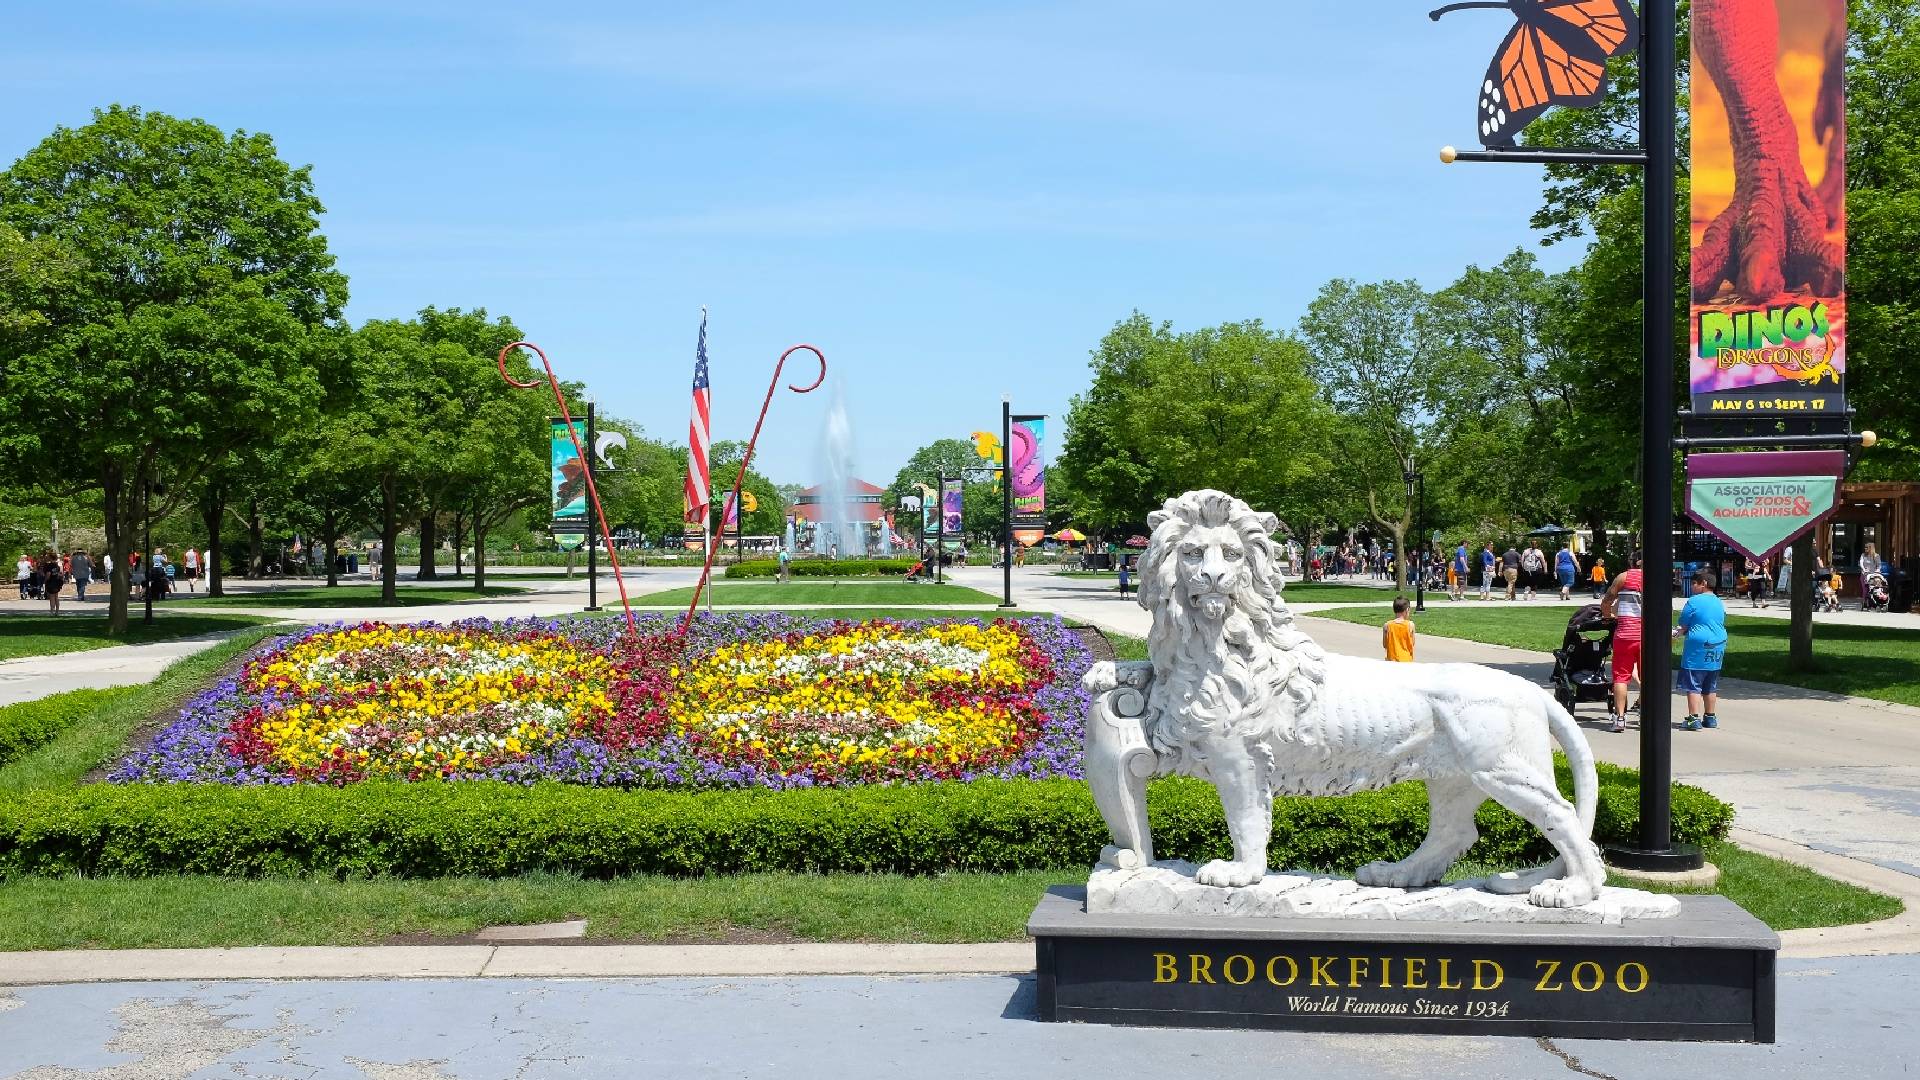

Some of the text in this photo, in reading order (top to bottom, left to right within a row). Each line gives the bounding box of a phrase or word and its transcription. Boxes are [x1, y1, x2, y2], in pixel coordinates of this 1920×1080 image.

[1698, 301, 1830, 358] DINOS
[1711, 398, 1825, 410] MAY 6 TO SEPT. 17
[1714, 484, 1806, 496] ASSOCIATION
[1713, 507, 1791, 518] AQUARIUMS
[1734, 495, 1812, 516] OF ZOOS &
[1152, 954, 1650, 993] BROOKFIELD ZOO
[1287, 996, 1511, 1018] World Famous Since 1934
